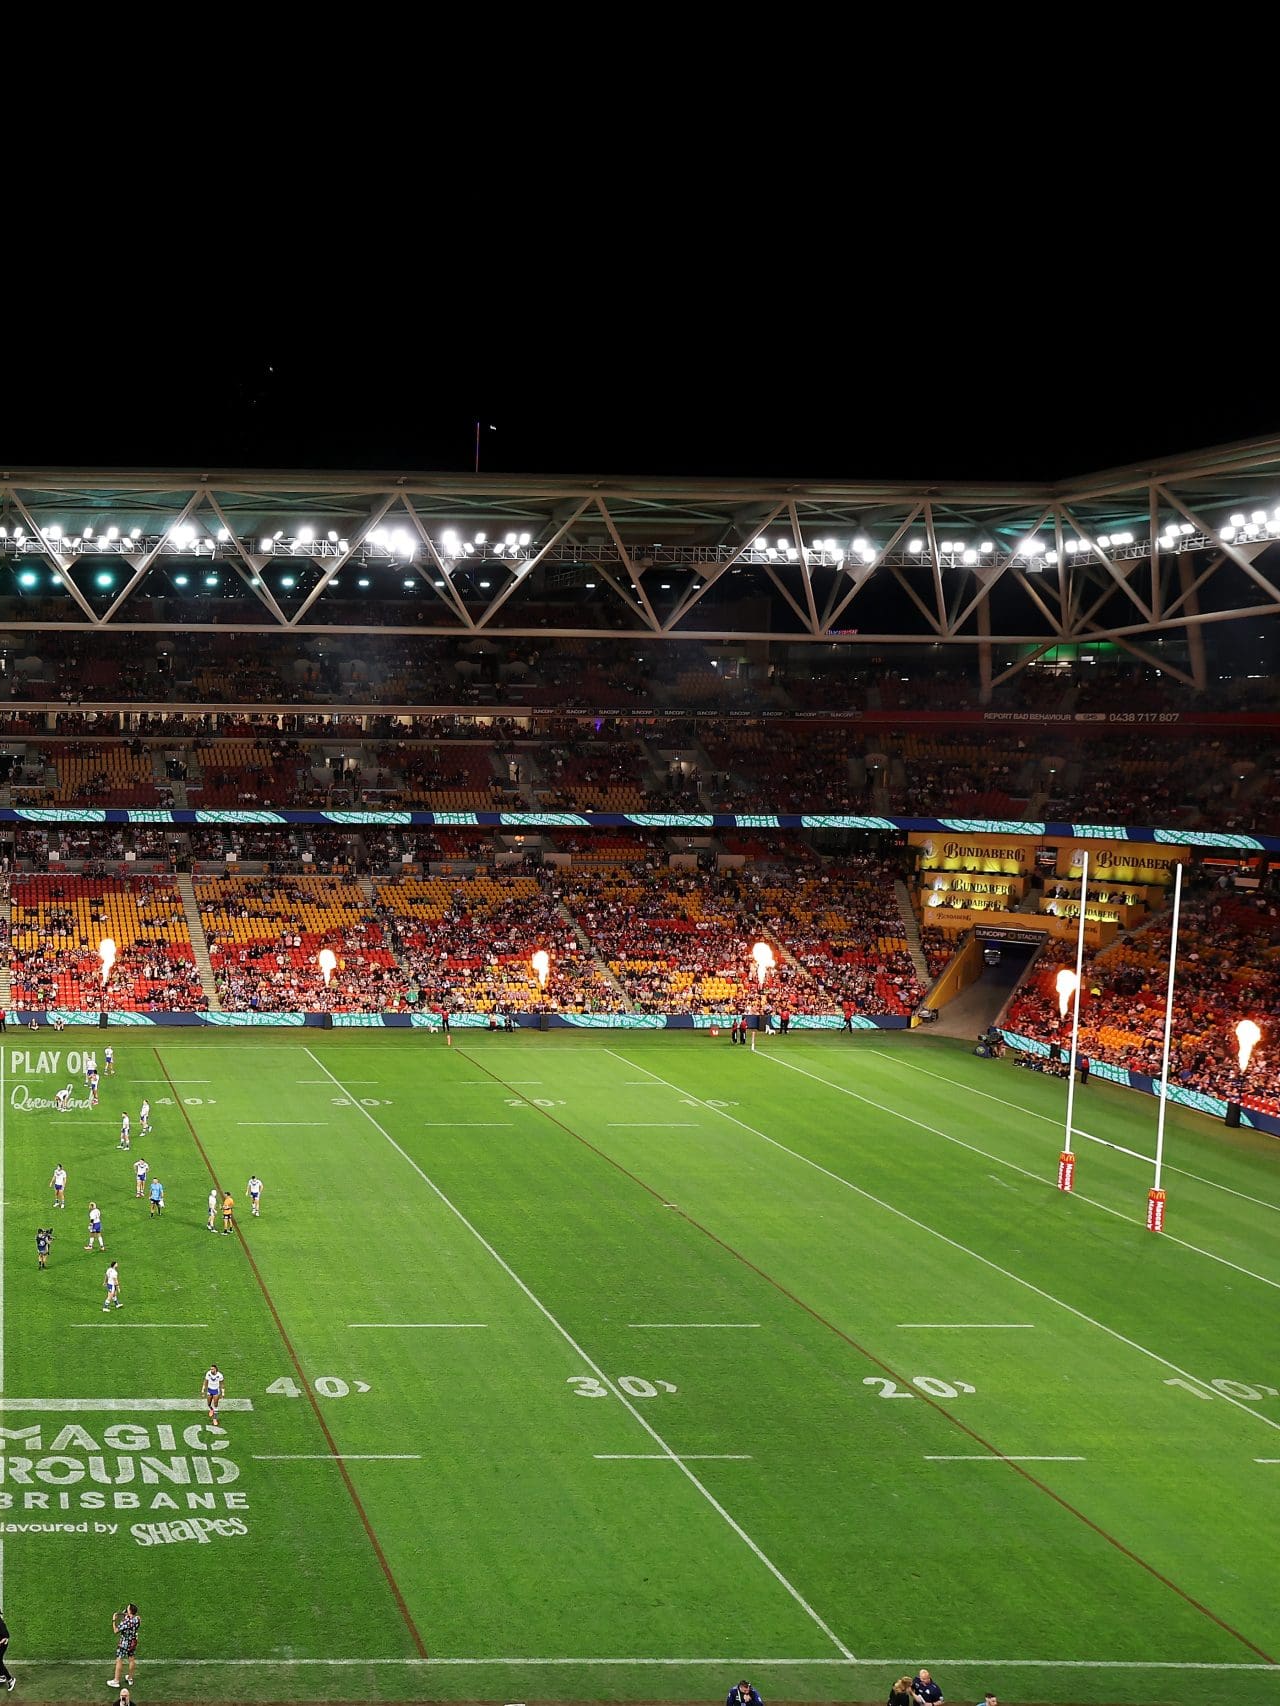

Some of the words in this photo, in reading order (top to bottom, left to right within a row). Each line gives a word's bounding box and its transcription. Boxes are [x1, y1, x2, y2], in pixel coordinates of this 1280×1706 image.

[983, 712, 1012, 720] REPORT
[1030, 713, 1071, 721] BEHAVIOUR
[1109, 713, 1135, 722] 0438
[1138, 713, 1157, 722] 717
[1159, 713, 1180, 722] 807
[976, 929, 1007, 938] SUNCORP
[11, 1051, 61, 1074] PLAY
[155, 1097, 203, 1105] 40
[330, 1098, 381, 1106] 30
[503, 1098, 555, 1107] 20
[265, 1376, 350, 1398] 40
[566, 1376, 658, 1398] 30
[862, 1376, 958, 1398] 20
[1163, 1378, 1263, 1401] 10
[93, 1521, 119, 1535] by
